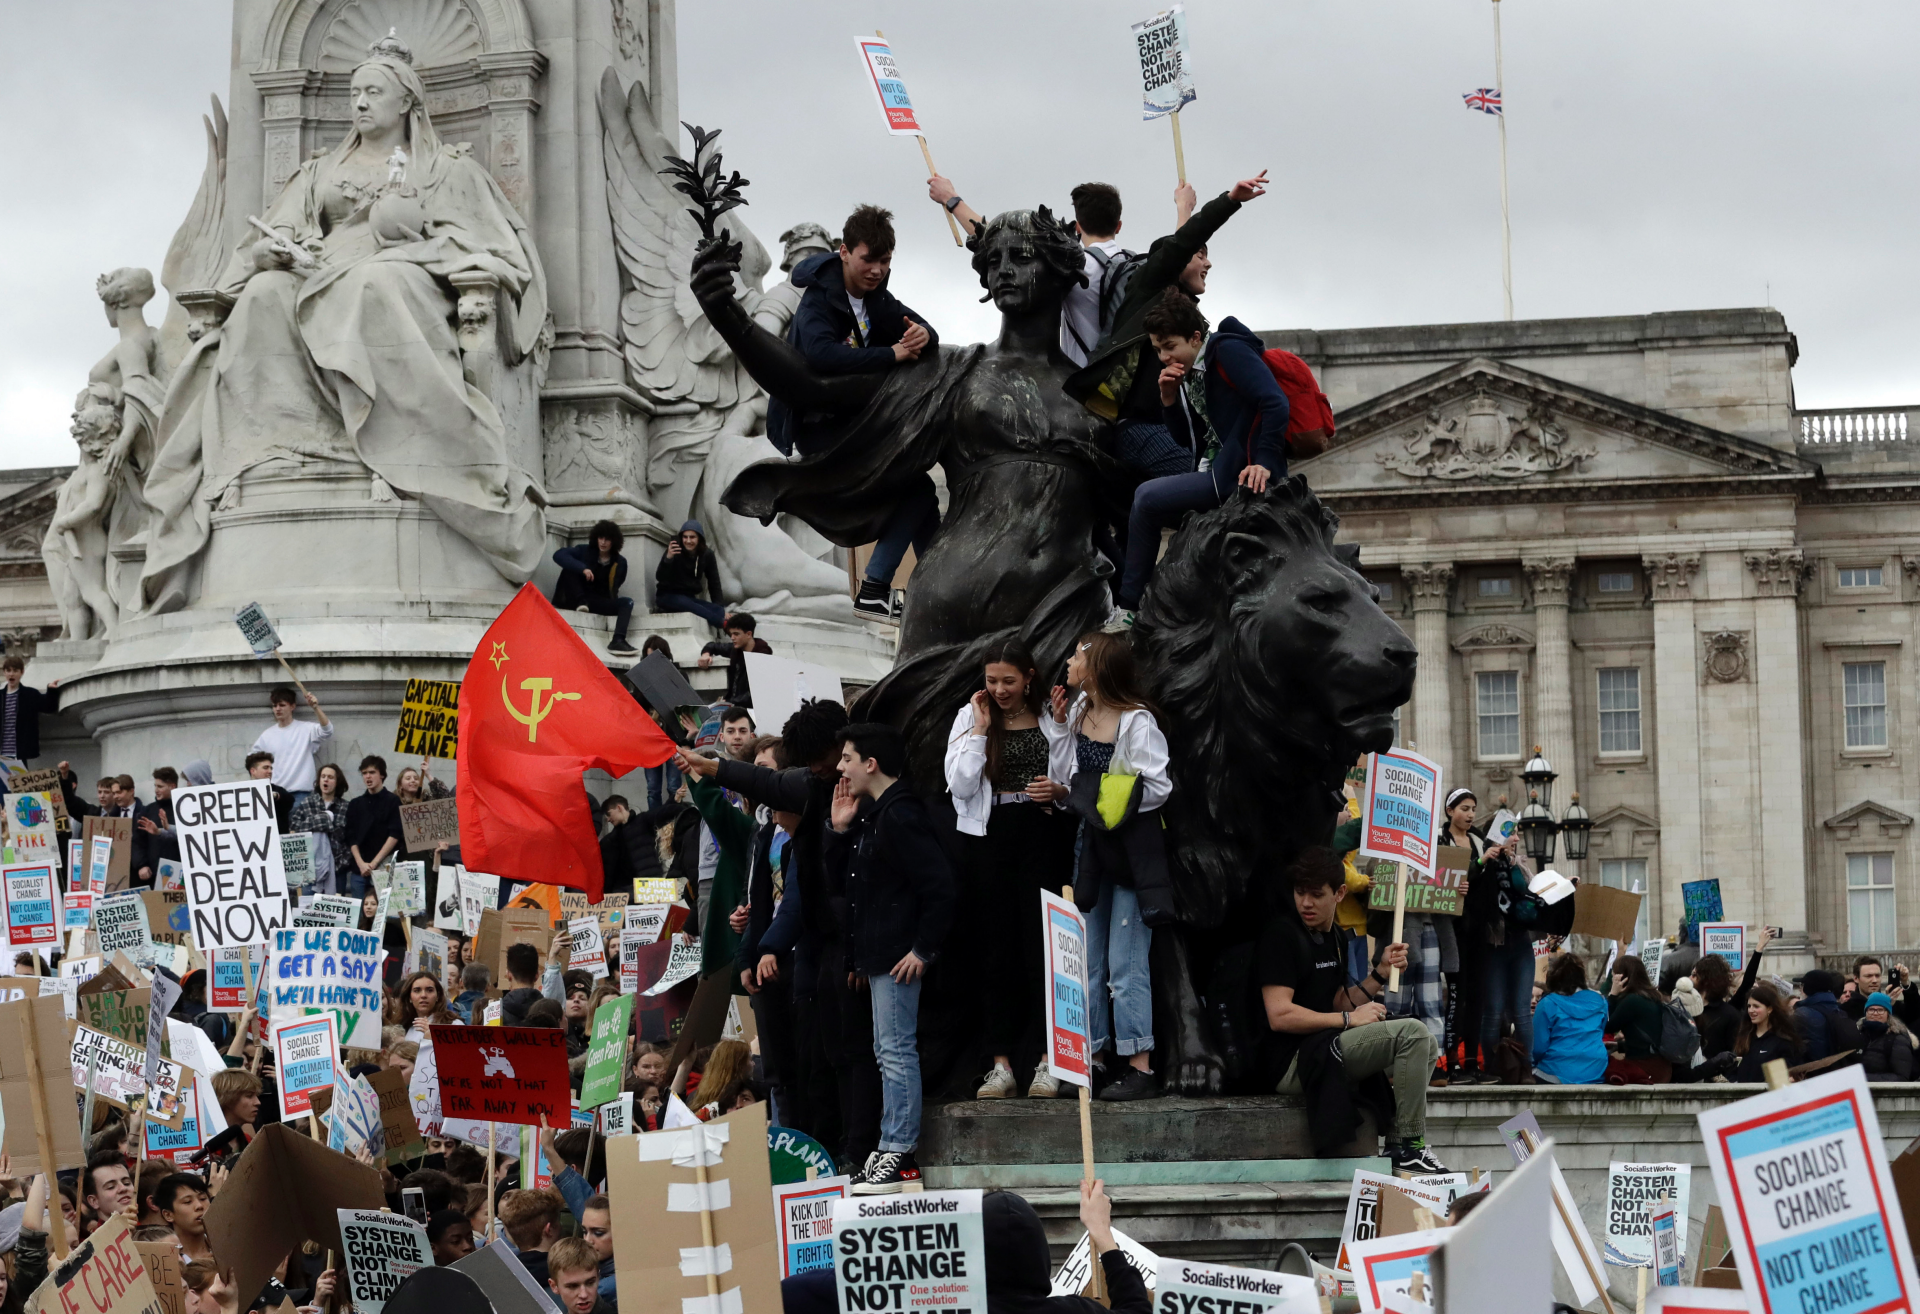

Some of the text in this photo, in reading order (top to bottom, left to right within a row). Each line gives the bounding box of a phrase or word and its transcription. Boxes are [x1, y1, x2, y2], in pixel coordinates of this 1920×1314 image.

[1144, 16, 1165, 30] Socialist
[1140, 51, 1164, 70] NOT
[880, 83, 895, 94] NOT
[236, 609, 258, 626] SYSTEM
[240, 613, 262, 630] CHANGE
[243, 625, 256, 636] NOT
[246, 622, 270, 640] CLIMATE
[400, 708, 446, 732] KILLING
[12, 770, 57, 789] I SHOULD
[1385, 768, 1428, 792] SOCIALIST
[1388, 782, 1422, 804] CHANGE
[176, 784, 274, 827] GREEN
[402, 802, 446, 816] ROSES ARE
[1376, 798, 1429, 825] NOT CLIMATE
[404, 810, 438, 822] VIOLETS
[1386, 814, 1420, 834] CHANGE
[406, 821, 422, 830] THE
[17, 834, 46, 848] FIRE
[408, 834, 426, 844] WHY
[1372, 829, 1391, 840] Young
[1373, 836, 1401, 847] Socialists
[185, 826, 272, 868] NEW
[281, 840, 306, 848] YSTEM
[282, 846, 308, 854] HANGE
[284, 858, 310, 866] LIMATE
[12, 878, 44, 890] SOCIALIST
[190, 866, 282, 905] DEAL
[482, 886, 499, 895] OUR
[638, 880, 674, 888] THINK
[16, 888, 42, 900] CHANGE
[1371, 884, 1457, 909] CLIATE CHA
[10, 902, 50, 914] NOT CLIMATE
[96, 904, 136, 918] SYSTEM
[302, 910, 318, 918] Socialist
[314, 902, 351, 915] SYSTEM
[1432, 901, 1456, 912] NGE
[18, 912, 44, 924] CHANGE
[98, 912, 140, 926] CHANGE
[194, 898, 288, 948] NOW
[294, 918, 335, 928] SYSTEM
[630, 916, 659, 928] TORIES
[99, 924, 120, 936] NOT
[101, 928, 144, 944] CLIMATE
[1710, 934, 1737, 942] SOCIALIST
[102, 938, 144, 952] CHANGE
[276, 930, 380, 956] IF WE DONT
[1644, 946, 1660, 956] SYSTEM
[1712, 942, 1734, 950] CHANGE
[670, 962, 686, 970] NOT
[1642, 954, 1660, 963] CHANGE
[72, 961, 88, 976] MY
[216, 965, 230, 974] NOT
[279, 954, 378, 983] GET A SAY
[319, 985, 380, 1012] HAVE TO
[1056, 982, 1070, 1002] NOT
[86, 990, 128, 1012] WHY
[90, 1005, 144, 1028] SHOULD
[596, 1018, 610, 1040] Vote
[80, 1028, 106, 1048] THE
[286, 1033, 323, 1050] SOCIALIST
[434, 1028, 565, 1047] REMEMBER WALL-E?
[1056, 1032, 1072, 1050] Young
[292, 1046, 320, 1060] CHANGE
[587, 1036, 624, 1068] Green Party
[1058, 1045, 1082, 1061] Socialists
[285, 1060, 330, 1078] NOT CLIMATE
[294, 1072, 323, 1088] CHANGE
[440, 1076, 548, 1091] WE'RE NOT THAT
[286, 1094, 300, 1102] Young
[288, 1098, 308, 1108] Socialists
[450, 1095, 476, 1112] FAR
[484, 1098, 516, 1114] AWAY
[148, 1124, 162, 1135] NOT
[158, 1134, 188, 1147] CHANGE
[774, 1132, 836, 1180] PLANET
[1624, 1164, 1653, 1172] Socialist
[1754, 1138, 1848, 1196] SOCIALIST
[1430, 1178, 1455, 1186] Worker
[1612, 1175, 1676, 1188] SYSTEM
[1612, 1187, 1678, 1200] CHANGE
[791, 1200, 828, 1222] KICK OUT
[858, 1198, 959, 1218] Socialist Worker
[1611, 1198, 1644, 1212] NOT
[1774, 1179, 1851, 1230] CHANGE
[354, 1212, 414, 1229] Socialist Worker
[344, 1226, 417, 1248] SYSTEM
[792, 1218, 833, 1240] THE TORIE
[839, 1222, 960, 1256] SYSTEM
[348, 1240, 424, 1264] CHANGE
[796, 1244, 821, 1264] FIGHT
[1764, 1222, 1883, 1289] NOT CLIMATE
[82, 1228, 145, 1314] CARE
[151, 1254, 174, 1286] BE
[350, 1256, 400, 1272] NOT One
[842, 1251, 967, 1284] CHANGE
[910, 1283, 969, 1295] One solution:
[1182, 1268, 1283, 1296] Socialist Worker
[845, 1282, 906, 1312] NOT
[1798, 1267, 1874, 1314] CHANGE
[911, 1296, 958, 1306] revolution
